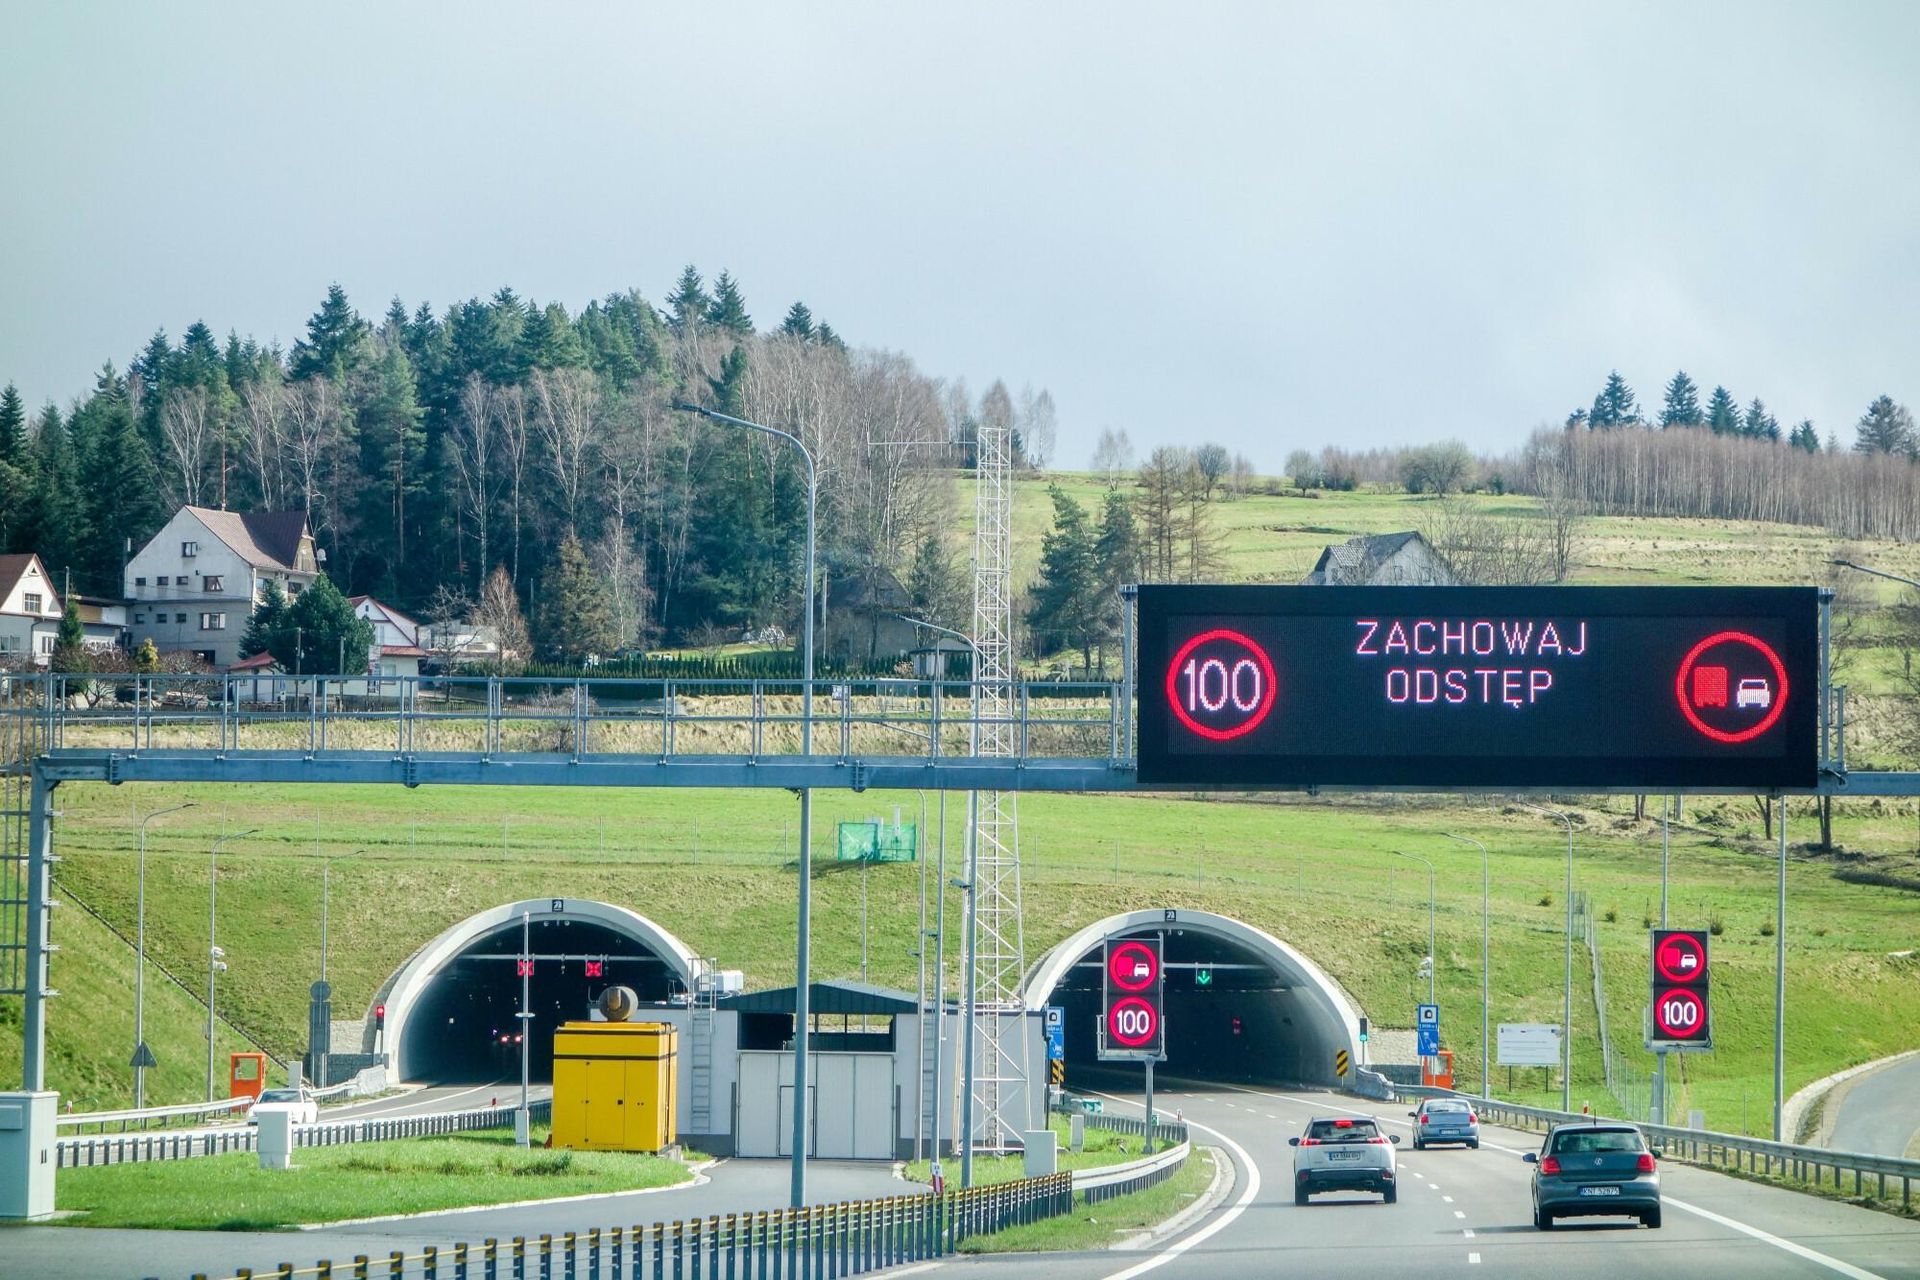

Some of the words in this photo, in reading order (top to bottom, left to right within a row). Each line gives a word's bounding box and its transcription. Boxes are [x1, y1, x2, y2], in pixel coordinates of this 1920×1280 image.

[1356, 621, 1585, 656] ZACHOWAJ
[1184, 659, 1261, 712] 100
[1387, 669, 1553, 709] ODSTĘP
[1116, 1009, 1150, 1035] 100
[1663, 1000, 1697, 1026] 100
